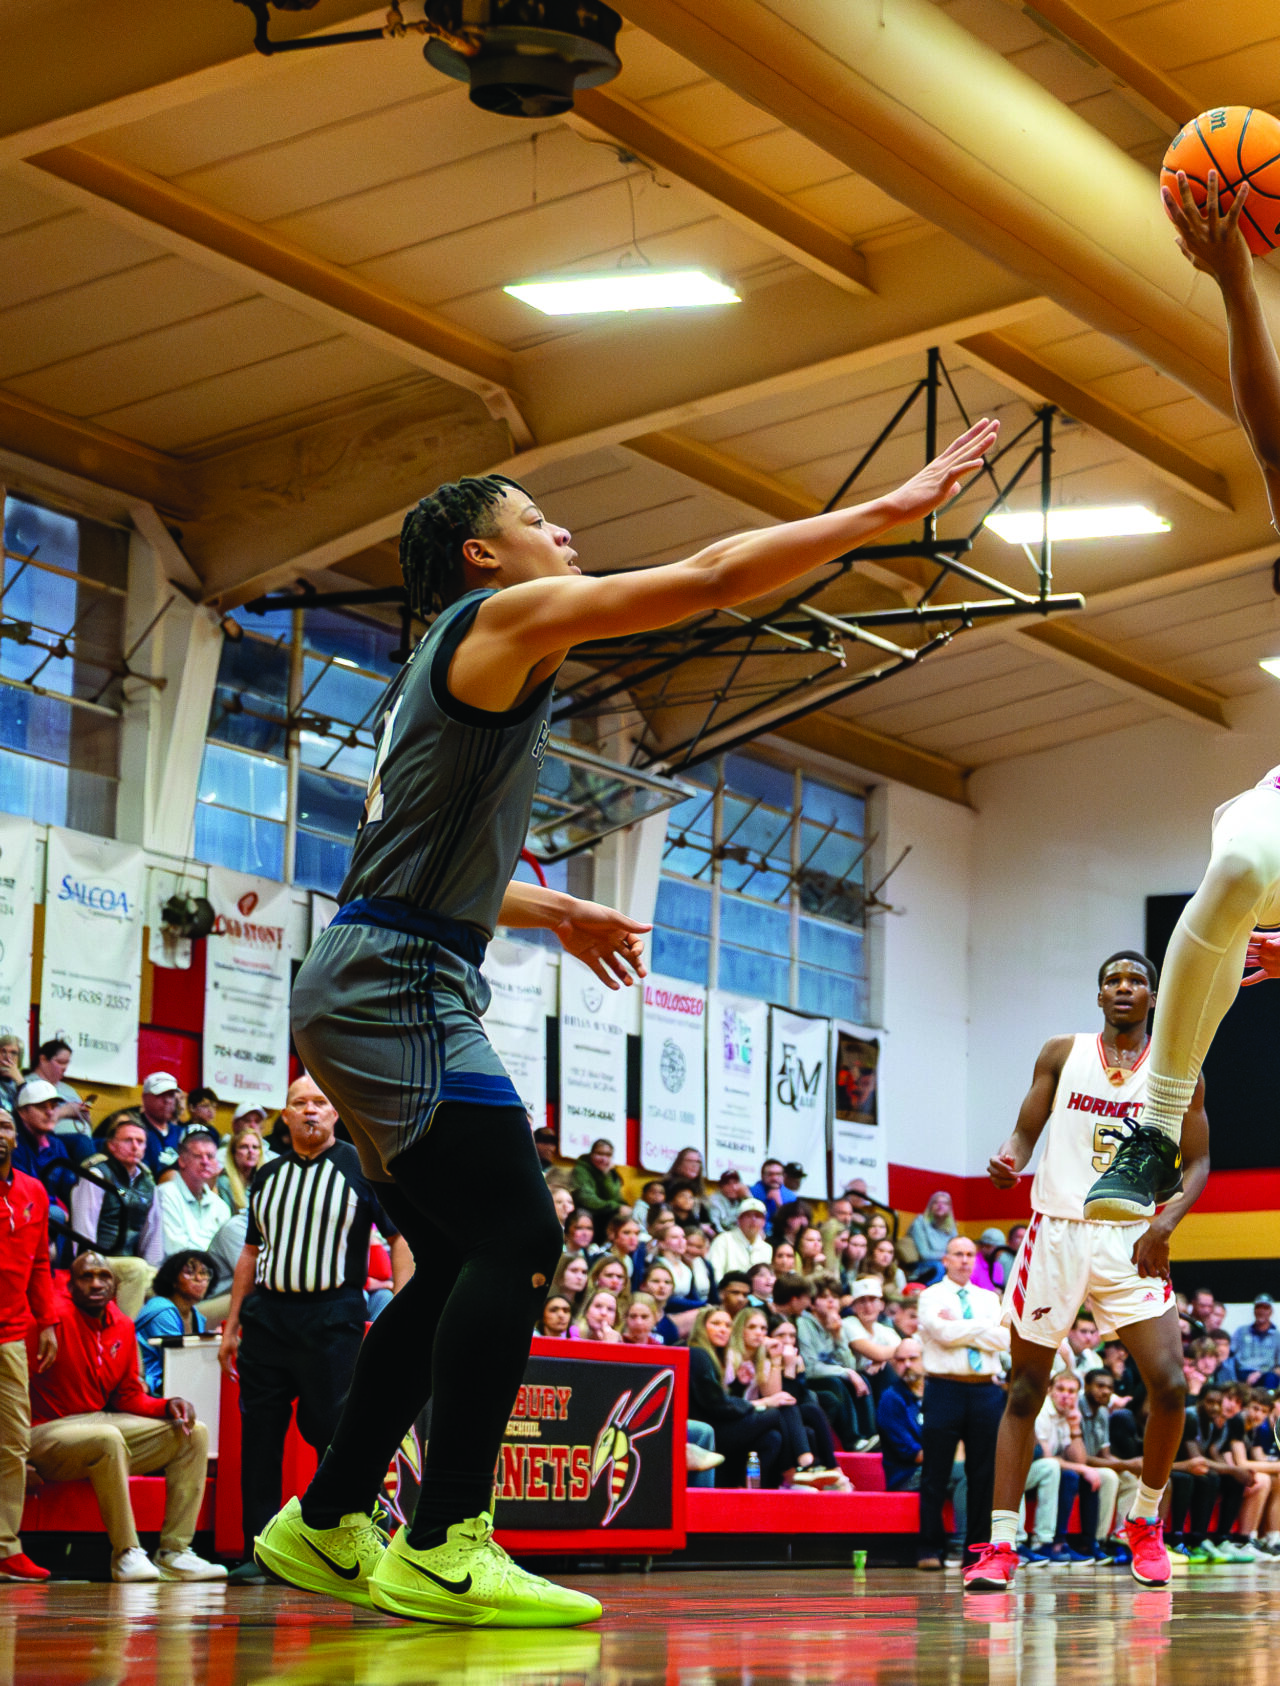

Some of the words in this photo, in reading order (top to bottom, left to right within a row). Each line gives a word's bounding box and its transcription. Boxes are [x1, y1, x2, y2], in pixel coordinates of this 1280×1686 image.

[656, 990, 704, 1017] COLOSSEO
[1067, 1092, 1144, 1119] HORNET
[1091, 1122, 1123, 1173] 5
[494, 1443, 592, 1501] NETS
